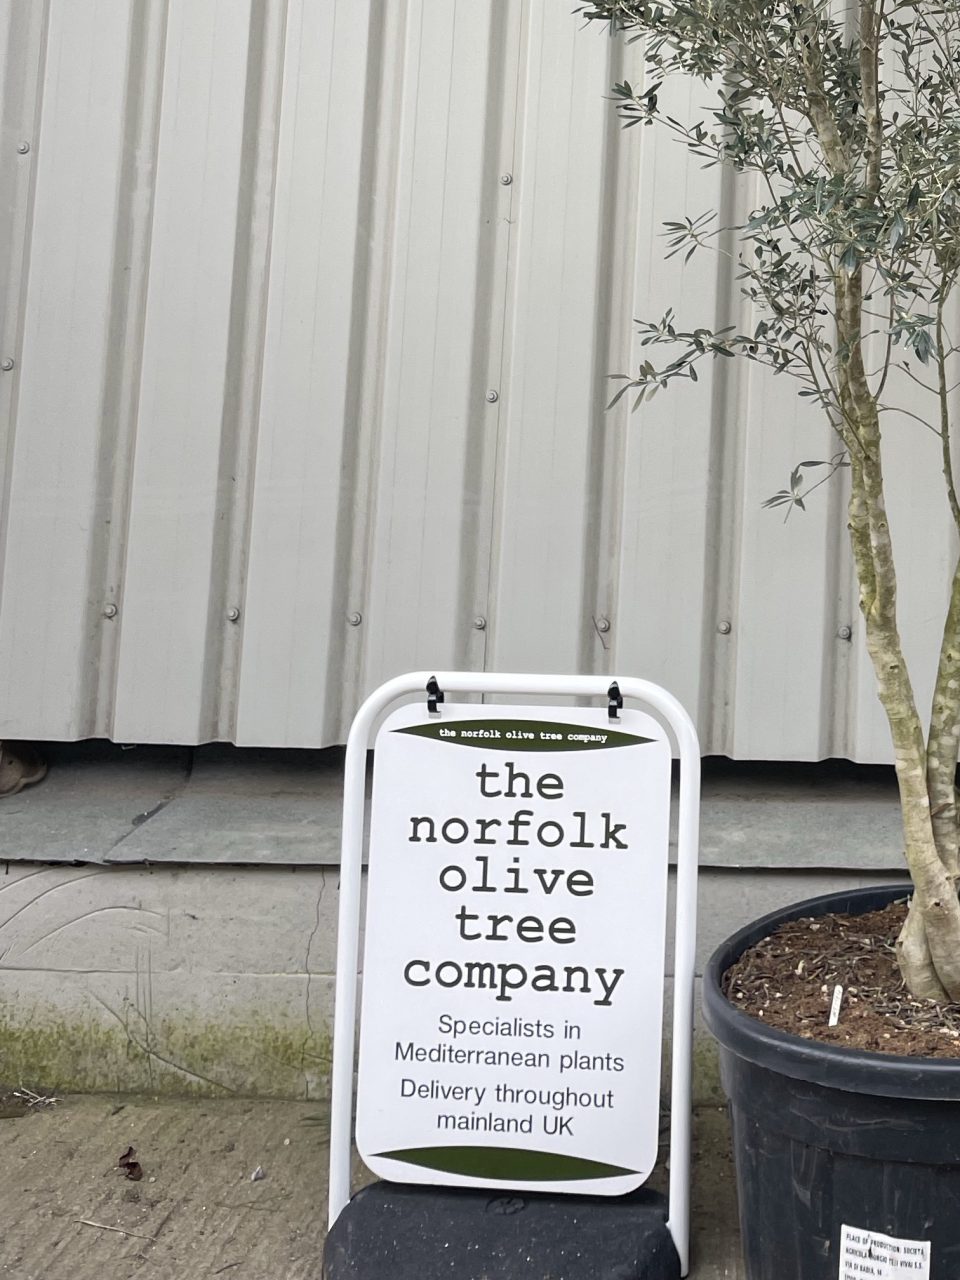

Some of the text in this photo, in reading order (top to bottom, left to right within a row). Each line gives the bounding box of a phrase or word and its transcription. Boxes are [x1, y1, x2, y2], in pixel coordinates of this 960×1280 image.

[439, 728, 608, 744] the norfolk olive tree company
[476, 762, 564, 799] the
[408, 809, 629, 850] norfolk
[439, 856, 594, 897] olive
[455, 905, 576, 944] tree
[404, 958, 625, 1006] company
[438, 1014, 581, 1040] Specialists in
[395, 1042, 624, 1074] Mediterranean plants
[400, 1079, 614, 1111] Delivery throughout
[437, 1110, 574, 1136] mainland UK
[846, 1233, 860, 1243] PLACE
